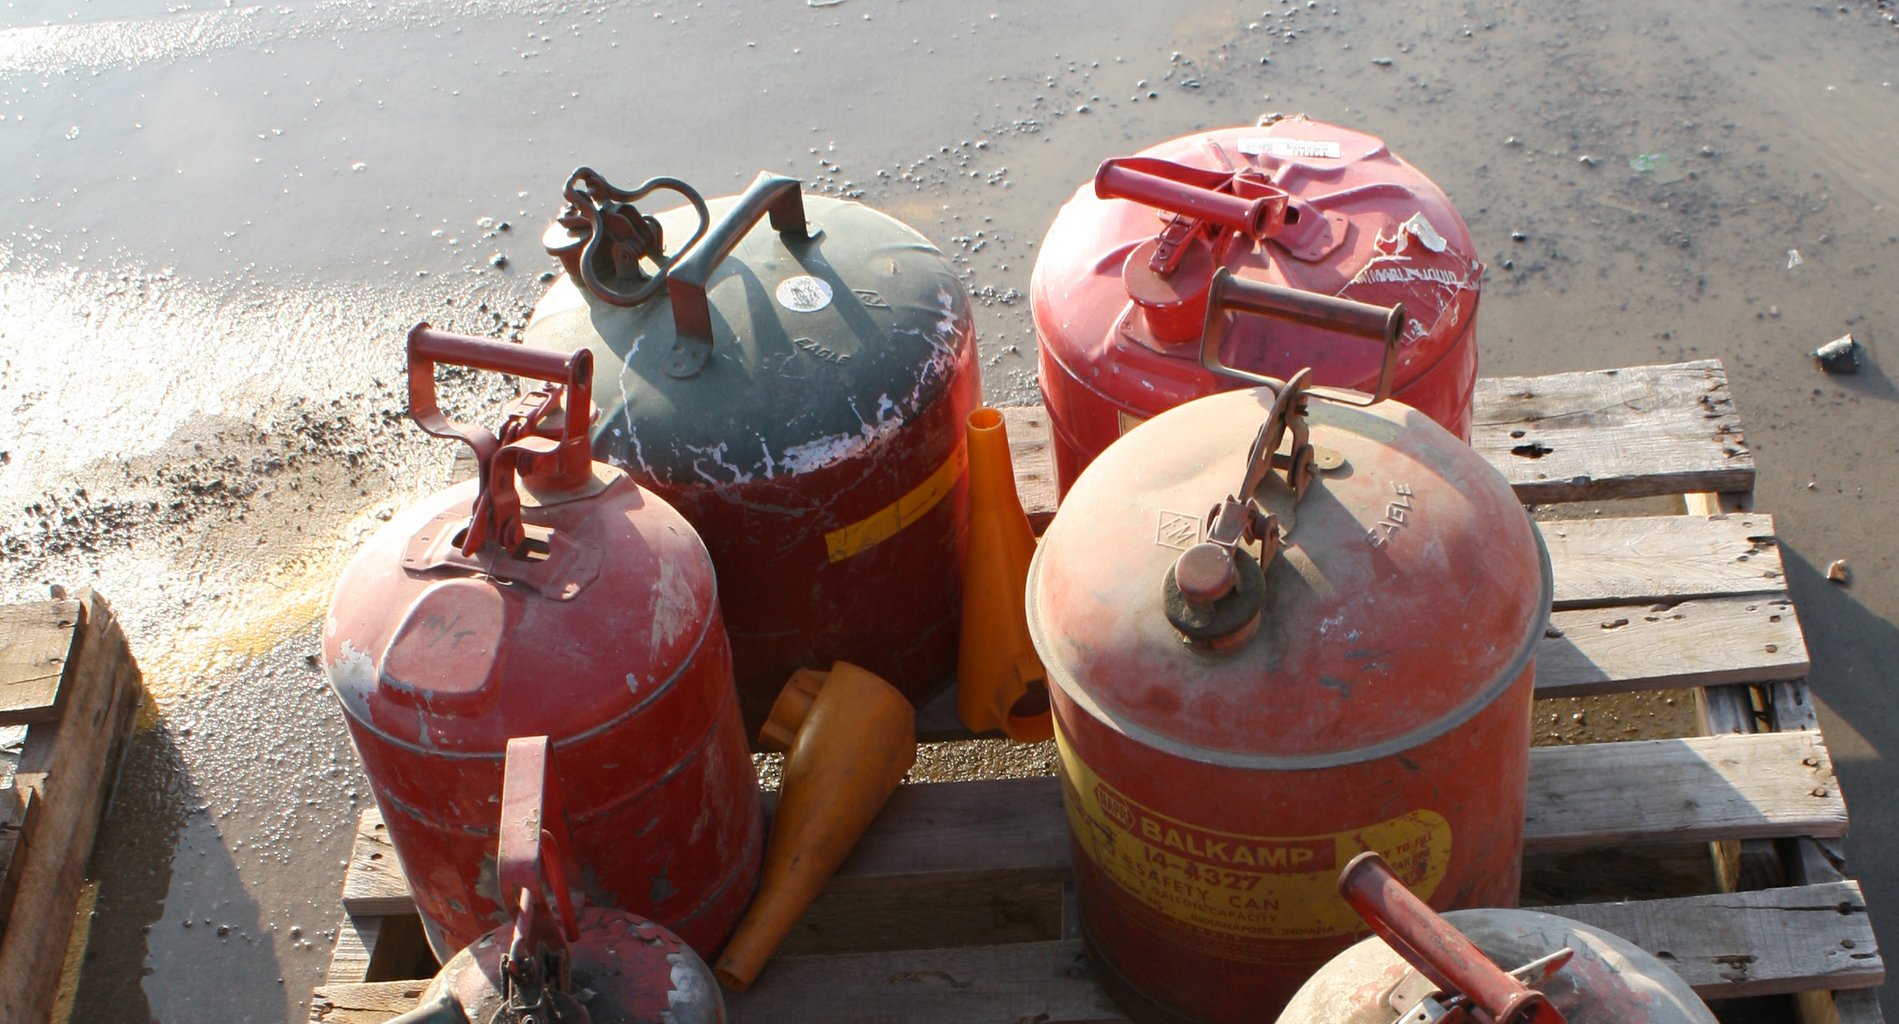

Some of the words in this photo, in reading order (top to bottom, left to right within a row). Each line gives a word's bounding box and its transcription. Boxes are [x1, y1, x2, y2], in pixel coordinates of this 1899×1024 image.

[793, 338, 851, 365] EAGLE
[1367, 480, 1412, 548] EAGLE
[1141, 816, 1314, 867] BALKAMP
[1136, 863, 1209, 900] SAFETY
[1229, 895, 1280, 911] CAN
[1144, 846, 1262, 891] 14-4327
[1152, 887, 1204, 911] GALLON
[1208, 906, 1277, 922] CAPACITY
[1281, 924, 1336, 936] INDIANA
